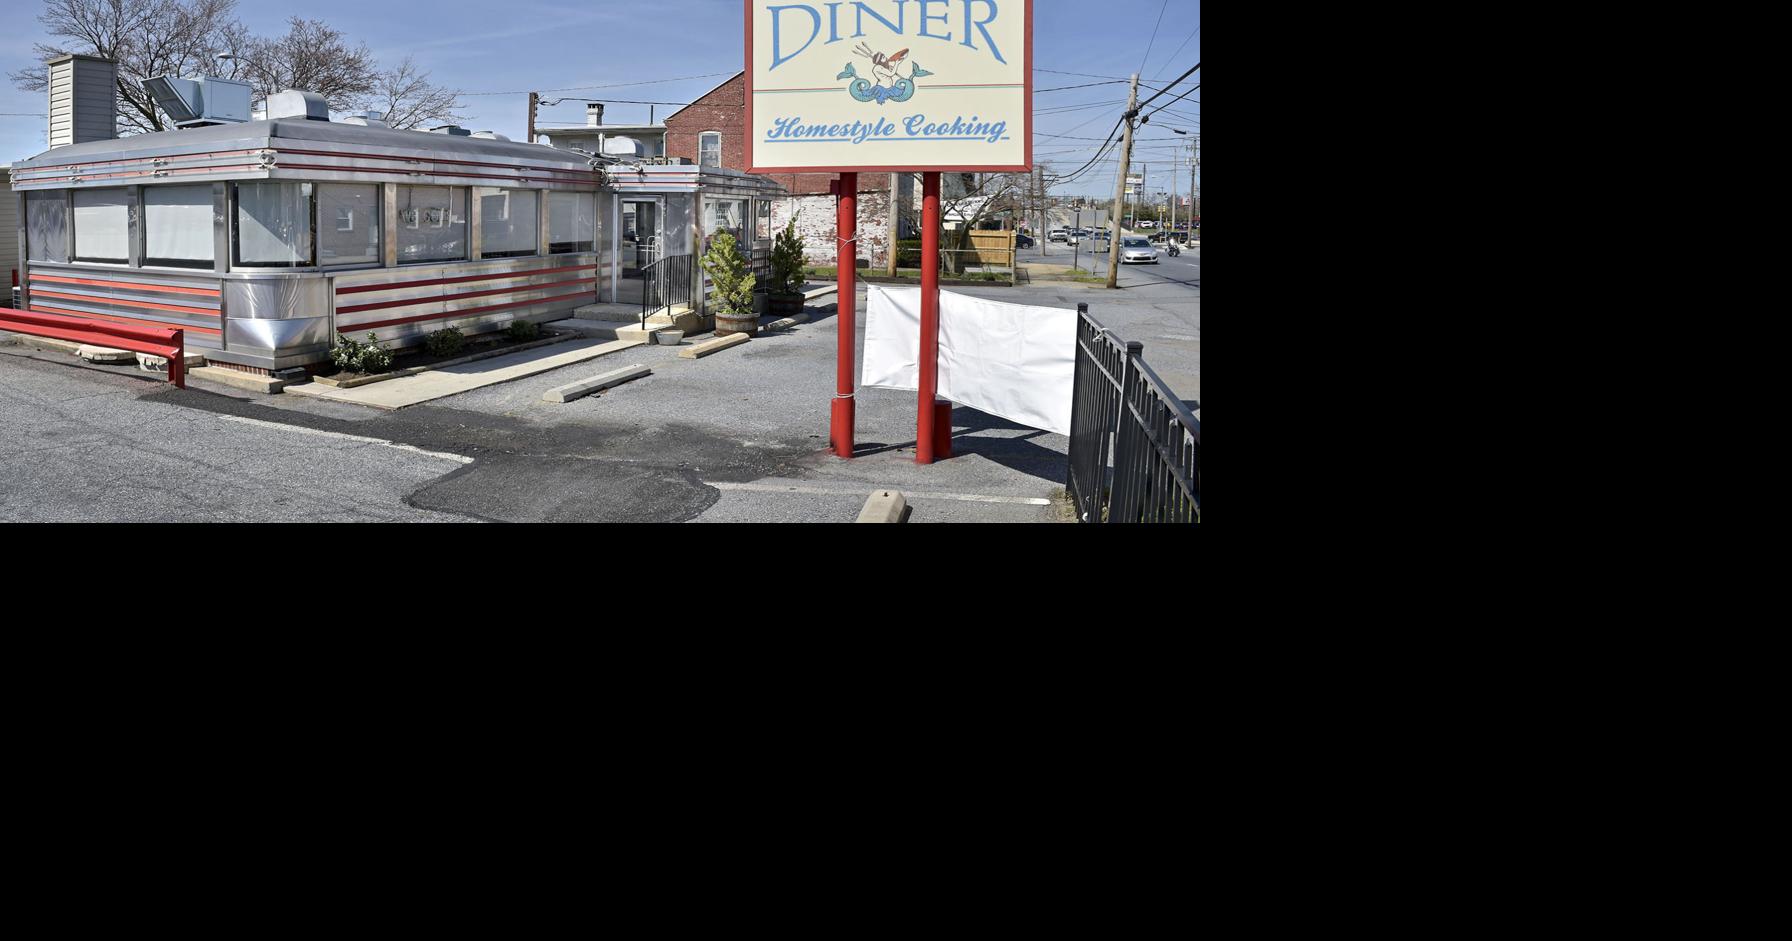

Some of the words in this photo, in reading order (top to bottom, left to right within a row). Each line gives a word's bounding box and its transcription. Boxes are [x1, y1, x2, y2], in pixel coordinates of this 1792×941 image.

[766, 0, 1007, 72] DINER
[767, 117, 896, 144] Homestyle
[902, 114, 1007, 143] Cooking
